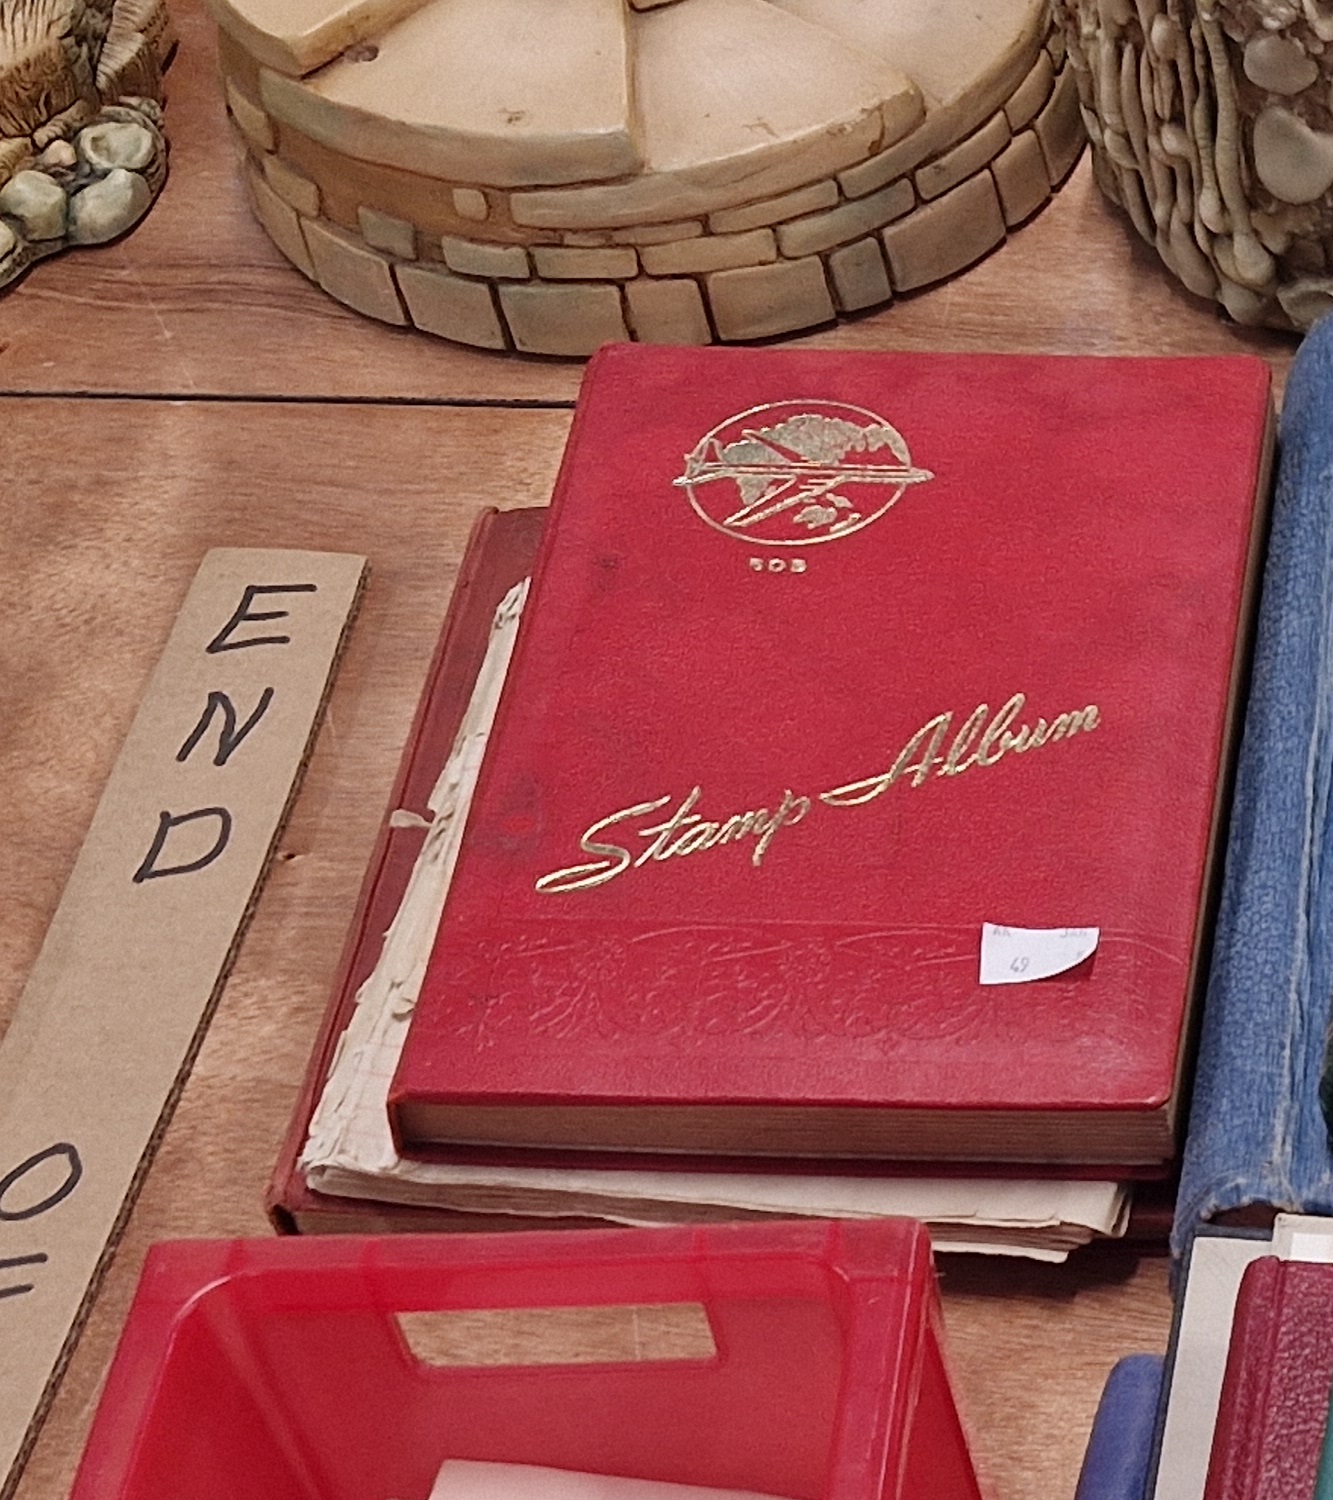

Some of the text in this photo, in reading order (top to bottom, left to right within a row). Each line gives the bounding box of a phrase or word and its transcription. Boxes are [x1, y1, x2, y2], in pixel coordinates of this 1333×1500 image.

[132, 583, 318, 883] END
[535, 692, 1100, 893] Stamp Album
